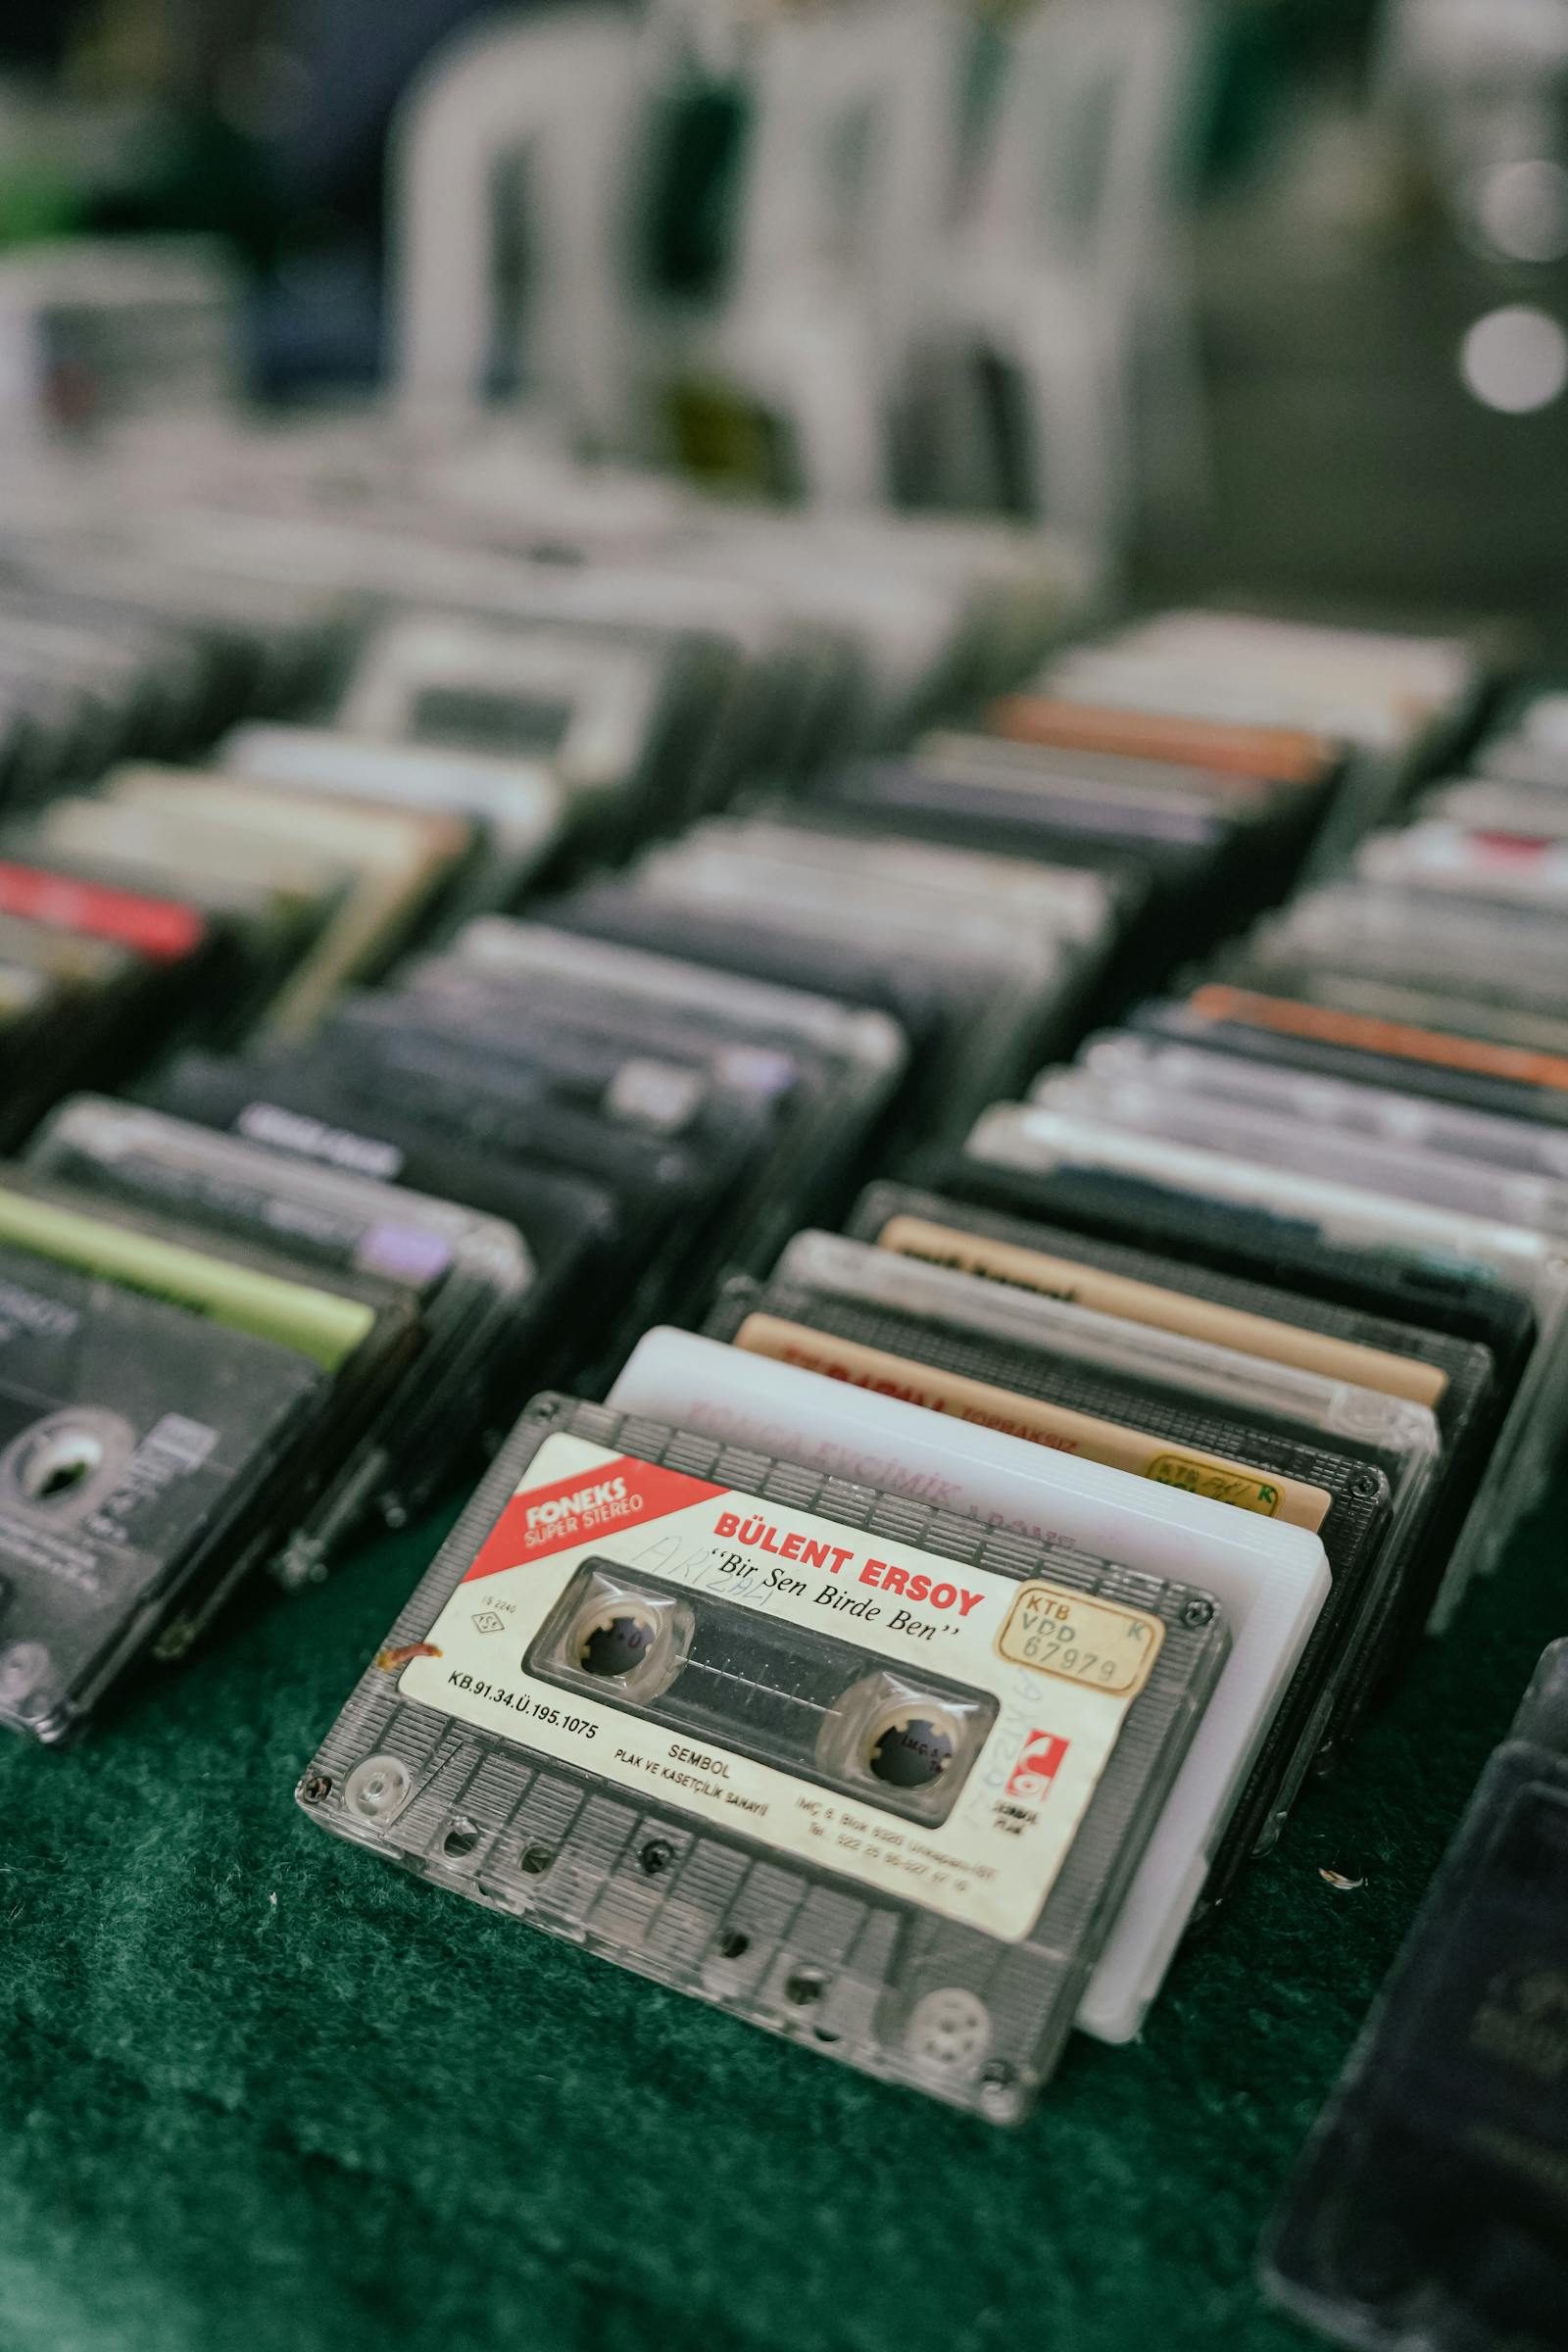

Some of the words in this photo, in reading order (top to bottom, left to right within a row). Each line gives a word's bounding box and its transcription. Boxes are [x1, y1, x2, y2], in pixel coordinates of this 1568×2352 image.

[525, 1477, 627, 1529] FONEKS
[1257, 1484, 1276, 1503] K
[523, 1517, 578, 1548] SUPER
[582, 1494, 643, 1528] STEREO
[713, 1512, 855, 1575] BÜLENT
[858, 1558, 985, 1617] ERSOY
[762, 1568, 807, 1596] Sen
[812, 1585, 881, 1622] Birde
[1026, 1594, 1070, 1621] KTB
[1127, 1621, 1146, 1641] K
[1022, 1636, 1116, 1682] 67979
[448, 1670, 599, 1739] KB.91.34.Ü.195.1075
[613, 1749, 644, 1768] PLAK
[645, 1760, 659, 1775] VE
[667, 1743, 730, 1779] SEMBOL
